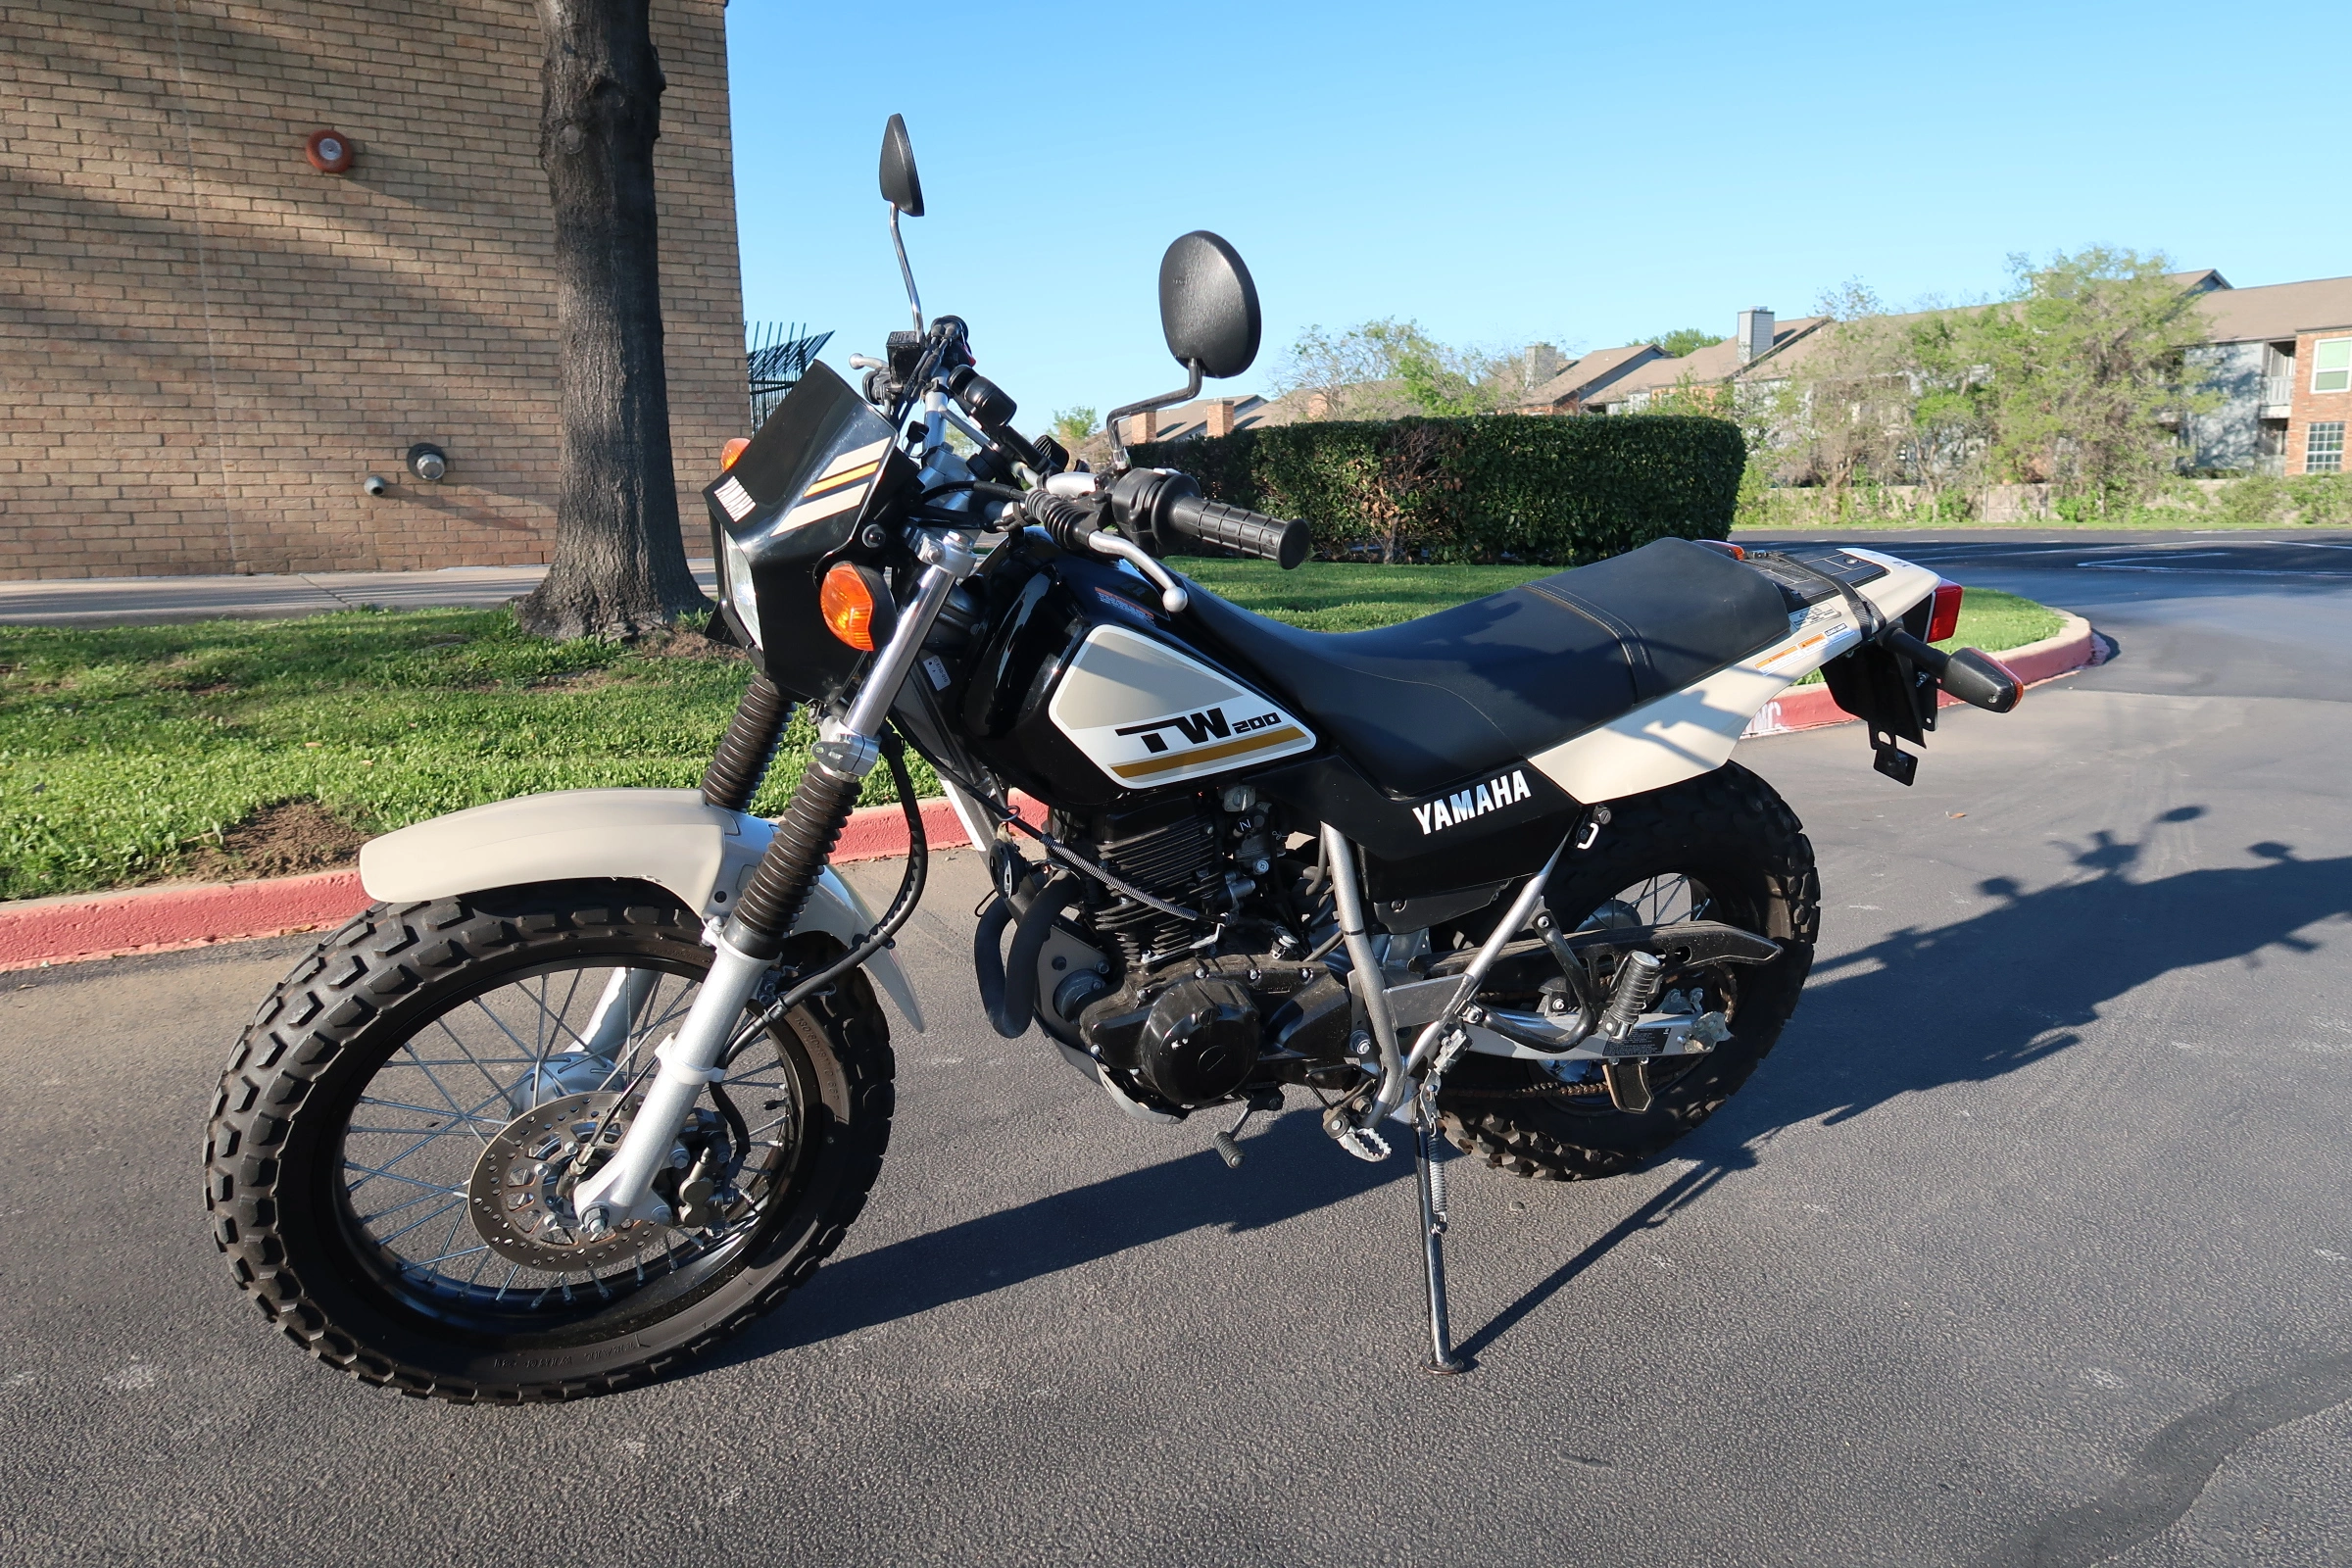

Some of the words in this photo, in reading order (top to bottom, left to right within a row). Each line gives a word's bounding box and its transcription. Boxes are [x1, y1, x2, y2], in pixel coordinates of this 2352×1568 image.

[713, 475, 757, 522] YAMAHA
[1114, 707, 1232, 754] TW
[1232, 711, 1282, 735] 200
[1412, 769, 1531, 835] YAMAHA
